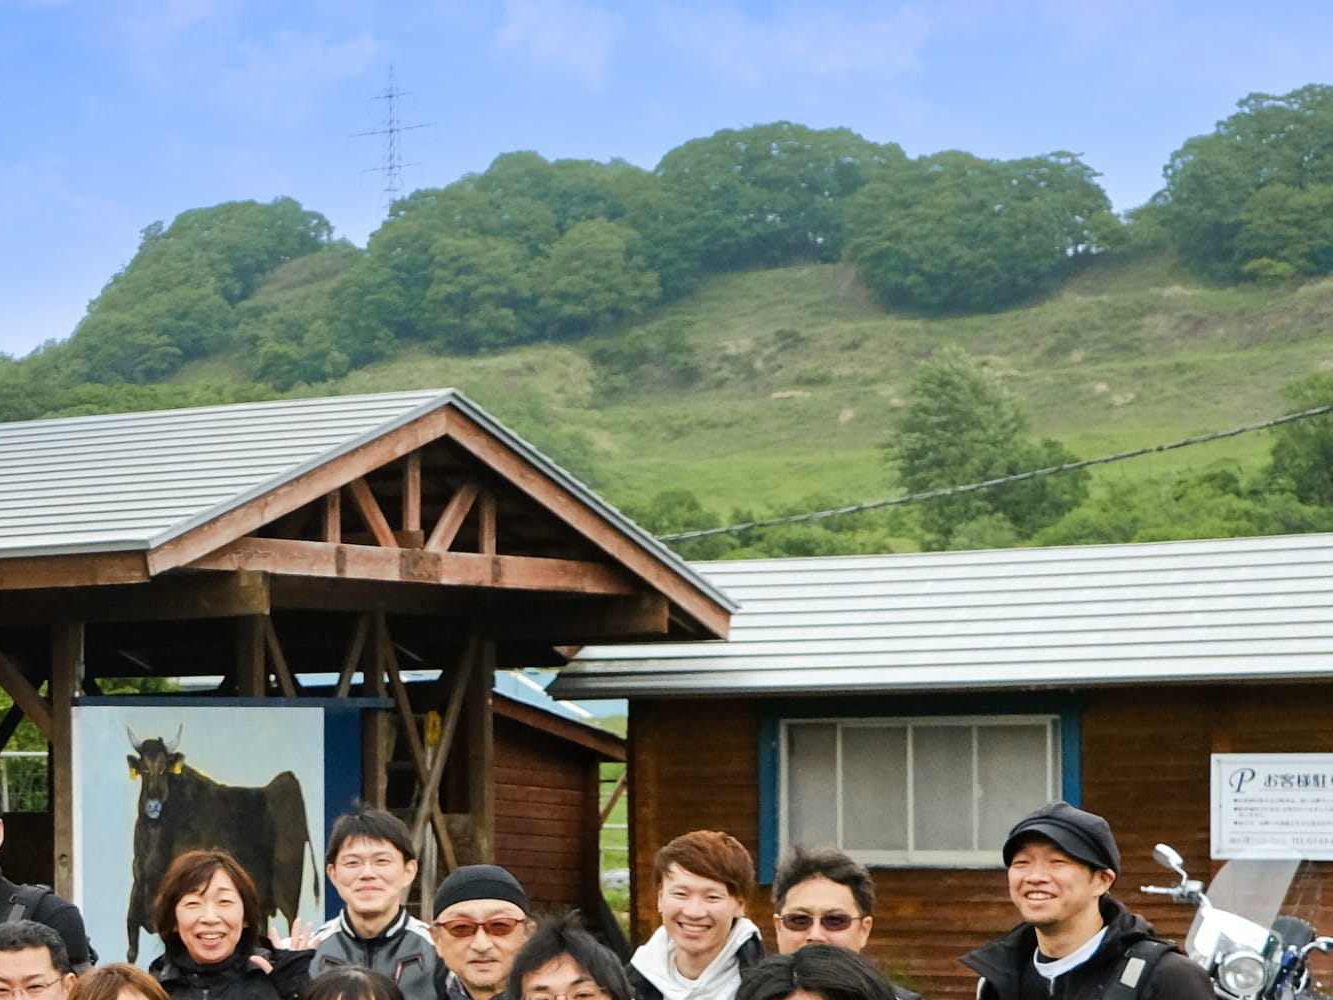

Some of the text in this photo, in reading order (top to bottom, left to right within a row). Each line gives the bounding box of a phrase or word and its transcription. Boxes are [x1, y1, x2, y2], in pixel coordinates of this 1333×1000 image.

[1229, 768, 1256, 793] P
[1264, 774, 1333, 788] お客様駐
